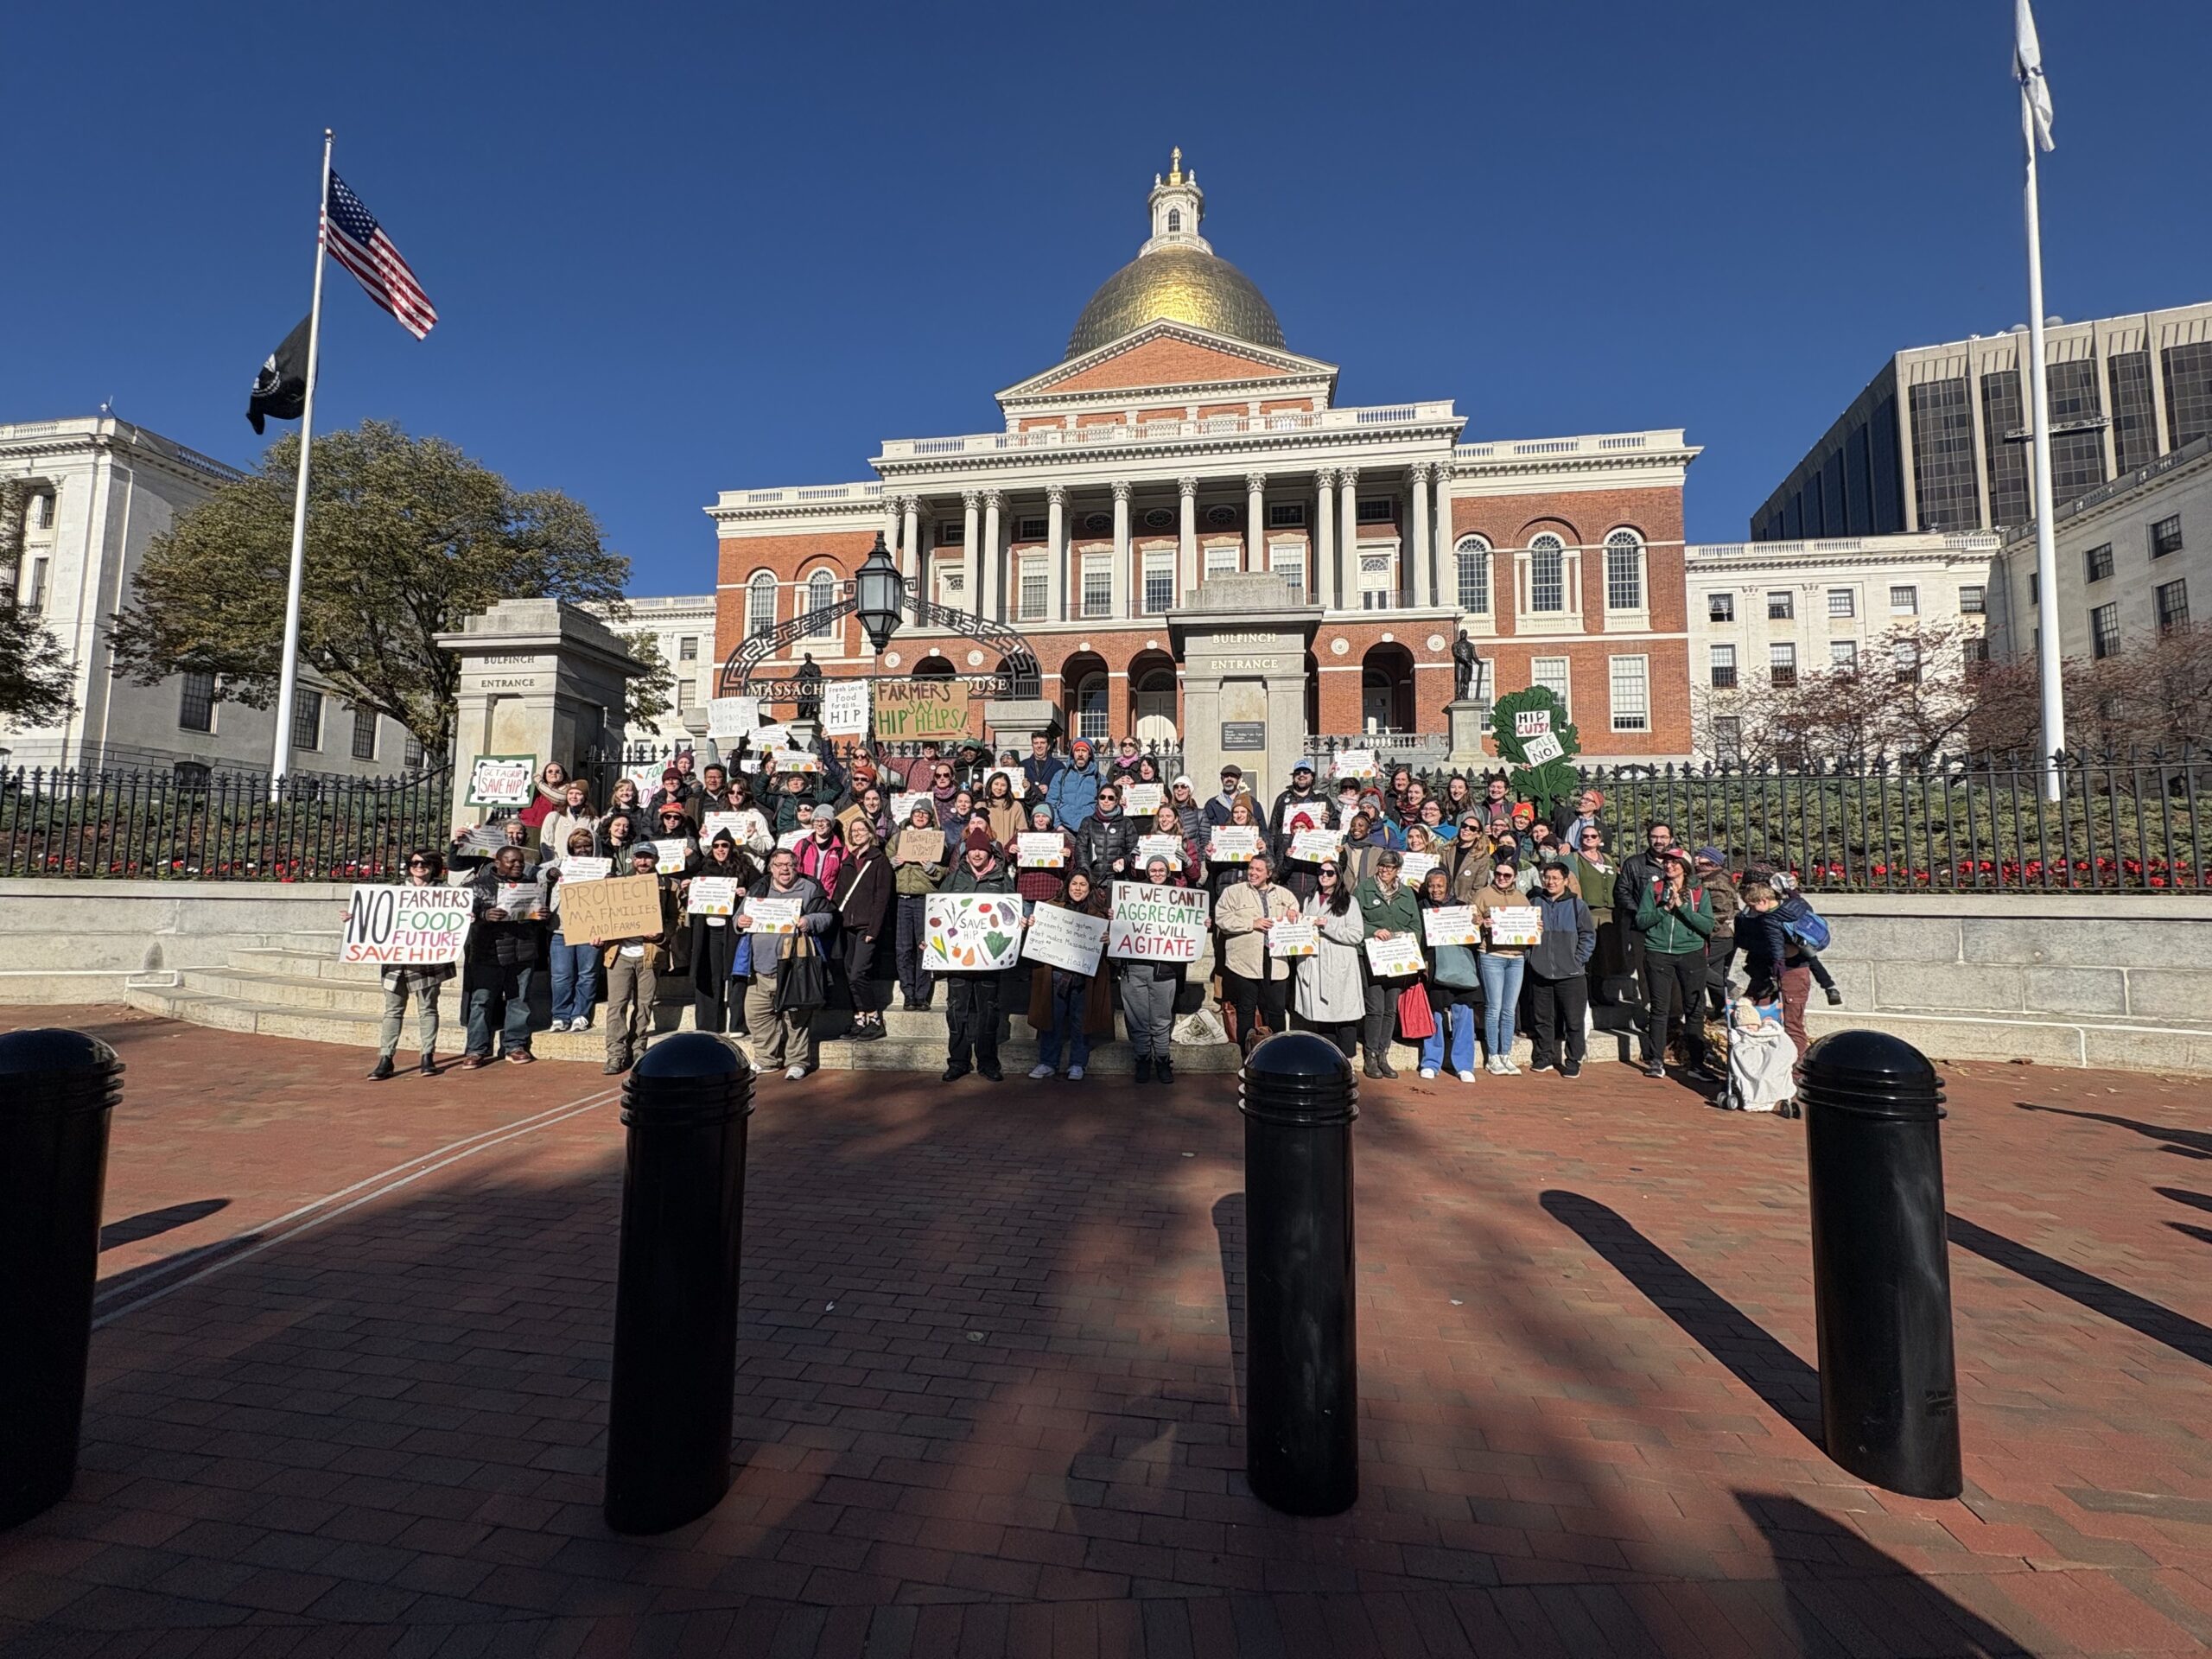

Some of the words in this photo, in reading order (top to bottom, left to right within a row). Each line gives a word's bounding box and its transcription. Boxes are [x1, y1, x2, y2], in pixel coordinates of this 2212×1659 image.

[1212, 633, 1276, 644] BULFINCH
[484, 656, 535, 664] BULFINCH
[1211, 659, 1279, 670] ENTRANCE
[481, 679, 535, 688] ENTRANCE
[750, 682, 824, 696] MASSACH
[968, 678, 1007, 691] OUSE
[878, 683, 950, 702] FARMERS
[836, 692, 857, 702] Food
[906, 700, 933, 715] SAY
[878, 709, 908, 734] HIP
[915, 709, 968, 733] HELPS!
[1518, 711, 1545, 723] HIP
[1526, 734, 1555, 753] KALE
[1532, 744, 1560, 762] NO!
[484, 768, 500, 777] GET
[480, 778, 506, 794] SAVE
[505, 779, 523, 794] HIP
[563, 880, 654, 909] PROTECT
[1118, 885, 1131, 900] IF
[1140, 887, 1163, 903] WE
[1169, 889, 1206, 908] CAN'T
[346, 890, 394, 944] NO
[398, 890, 470, 908] FARMERS
[396, 910, 465, 931] FOOD
[569, 910, 594, 925] MA
[600, 905, 658, 920] FAMILIES
[1116, 902, 1205, 925] AGGREGATE
[589, 923, 609, 938] AND
[613, 921, 641, 931] FARMS
[959, 918, 988, 930] SAVE
[1132, 922, 1153, 934] WE
[1159, 925, 1187, 938] WILL
[391, 930, 461, 948] FUTURE
[1117, 934, 1196, 957] AGITATE
[346, 944, 404, 962] SAVE
[409, 947, 456, 962] HIP!
